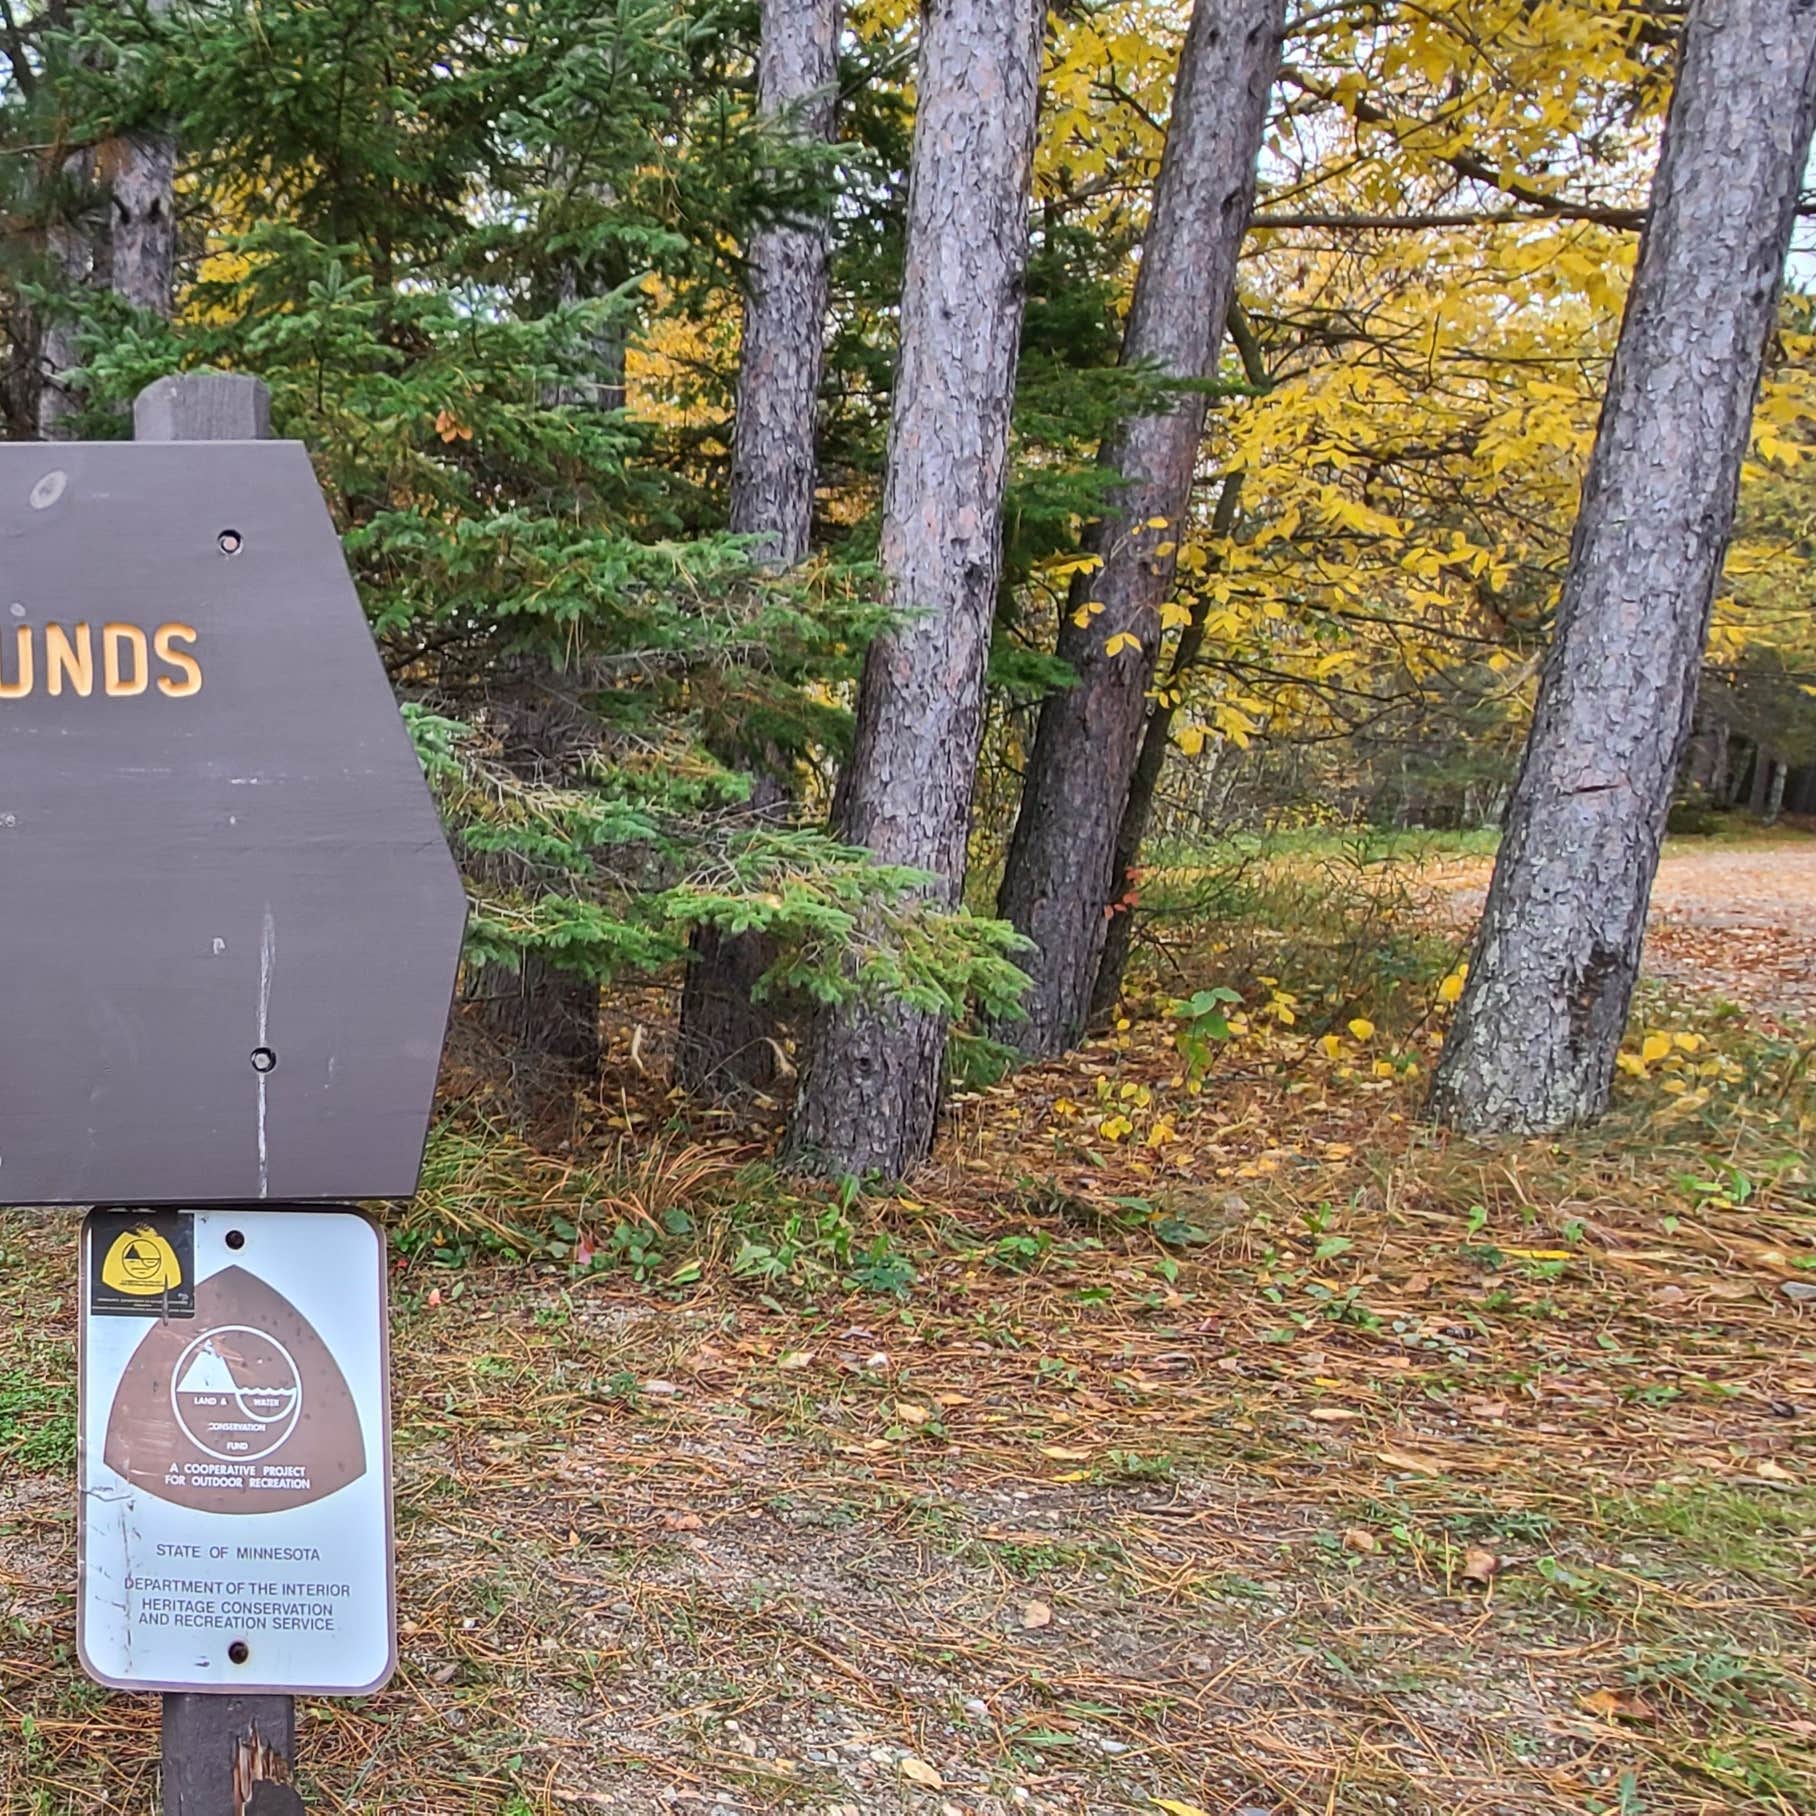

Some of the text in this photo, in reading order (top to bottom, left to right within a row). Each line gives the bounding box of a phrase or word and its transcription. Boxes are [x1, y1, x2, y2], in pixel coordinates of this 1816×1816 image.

[194, 1397, 217, 1405] LAND
[253, 1398, 280, 1407] WATER
[207, 1422, 266, 1432] CONSERVATION
[226, 1442, 249, 1450] FUND
[169, 1462, 306, 1477] A COOPERATIVE PROJECT
[165, 1475, 310, 1489] FOR OUTDOOR RECREATION
[156, 1543, 321, 1561] STATE OF MINNESOTA
[124, 1577, 351, 1598] DEPARTMENT OF THE INTERIOR
[142, 1598, 333, 1616] HERITAGE CONSERVATION
[138, 1612, 335, 1631] AND RECREATION SERVICE
